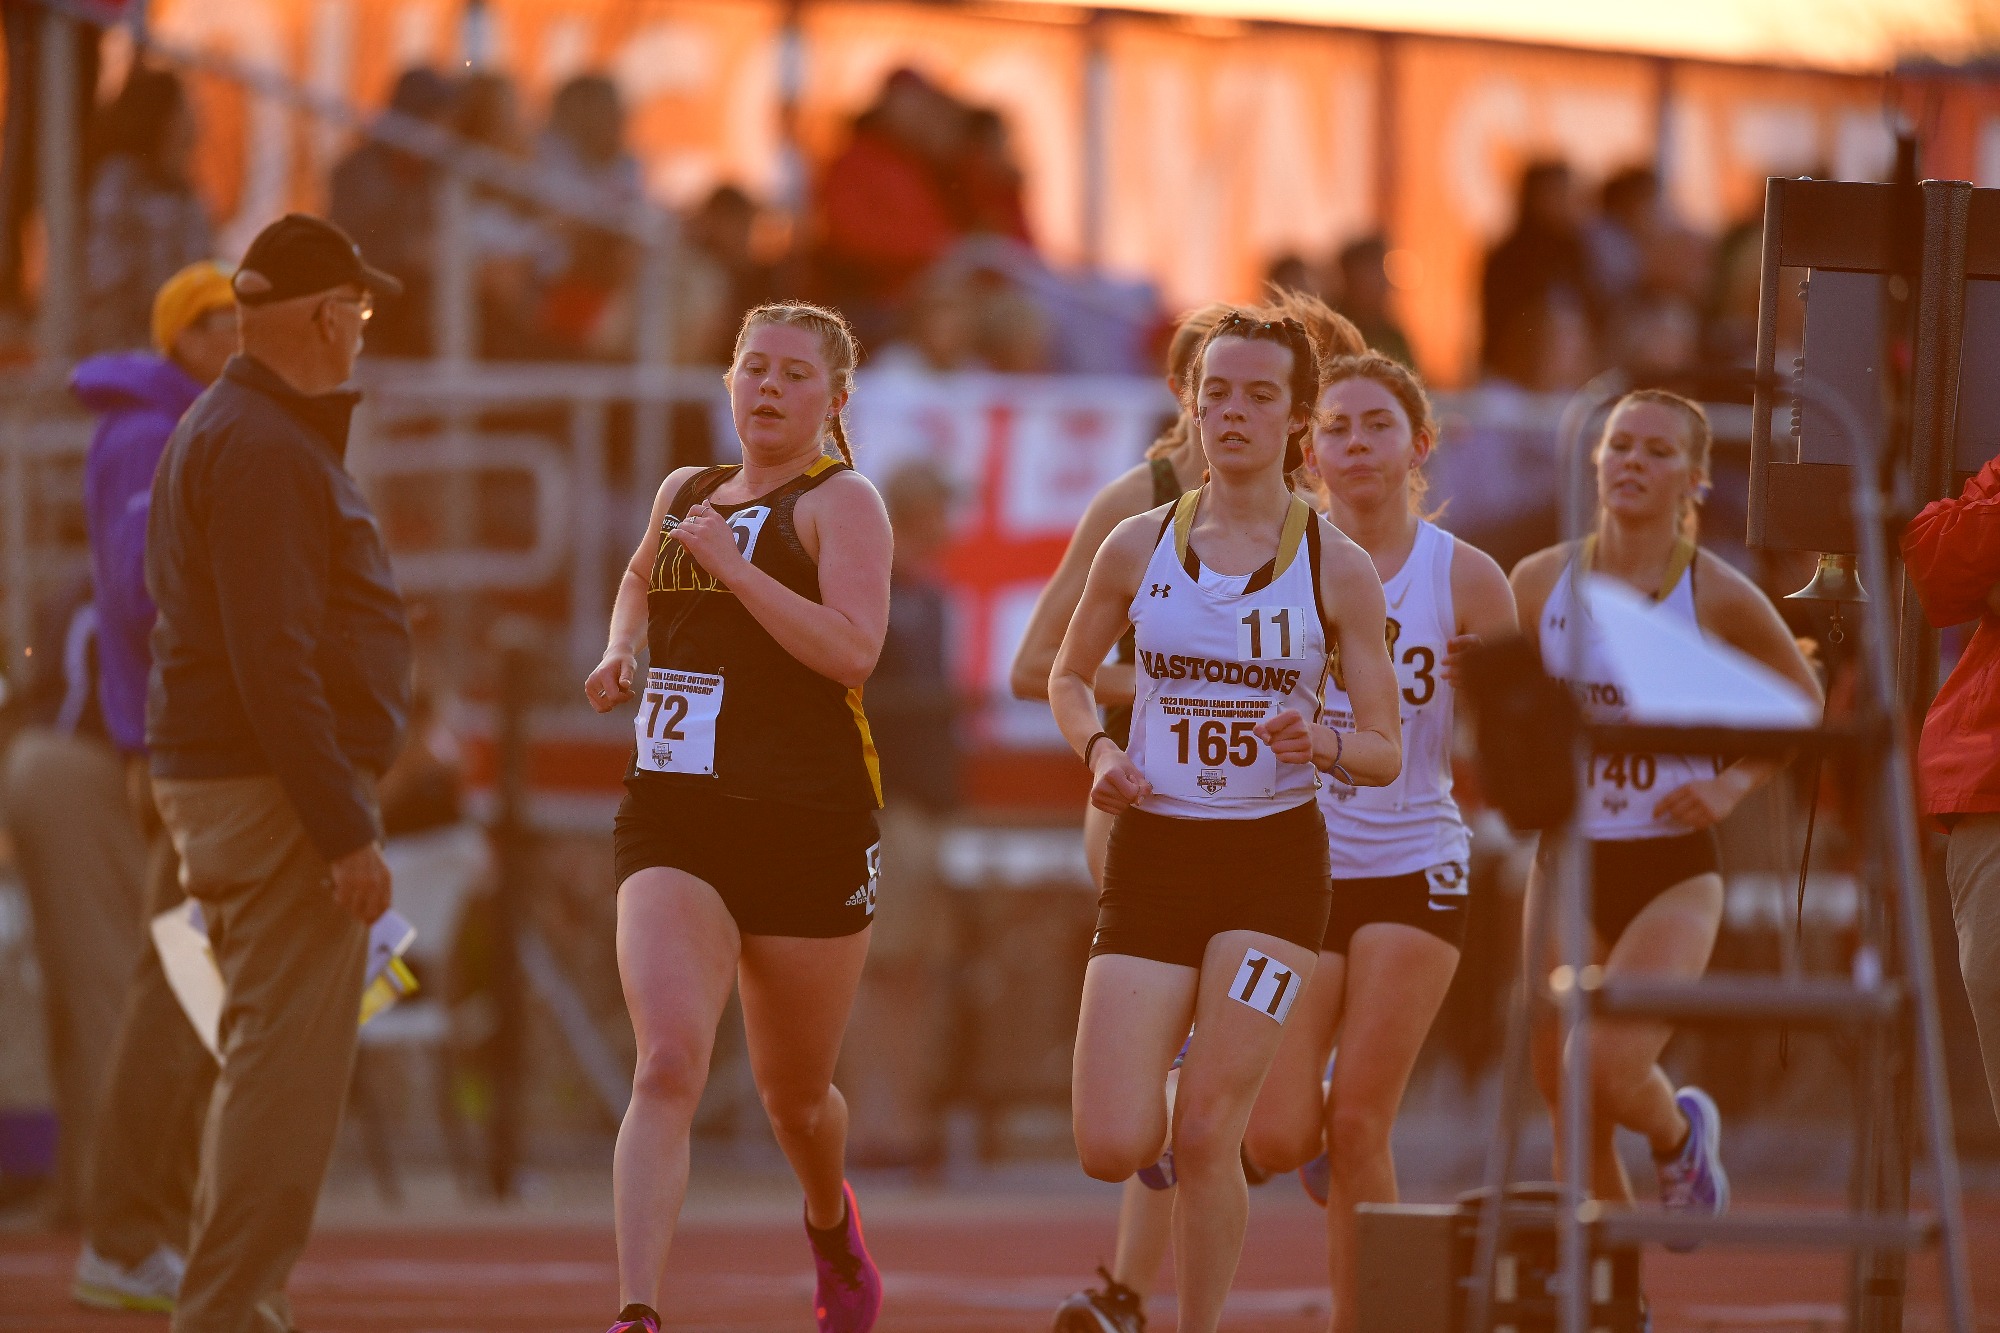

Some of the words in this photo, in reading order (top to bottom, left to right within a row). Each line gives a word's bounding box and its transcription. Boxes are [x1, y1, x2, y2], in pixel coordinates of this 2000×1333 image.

[1241, 609, 1291, 659] 11
[663, 672, 687, 683] LEAGUE
[664, 682, 713, 695] CHAMPIONSHIP
[1139, 649, 1300, 695] MASTODONS
[1402, 647, 1435, 706] 3
[646, 692, 689, 741] 72
[1159, 697, 1178, 706] 2023
[1178, 698, 1208, 708] HORIZON
[1209, 700, 1235, 709] LEAGUE
[1235, 701, 1270, 709] OUTDOOR
[1163, 706, 1185, 715] TRACK
[1193, 708, 1210, 718] FIELD
[1211, 710, 1266, 719] CHAMPIONSHIP
[1170, 718, 1258, 768] 165
[1240, 956, 1292, 1016] 11
